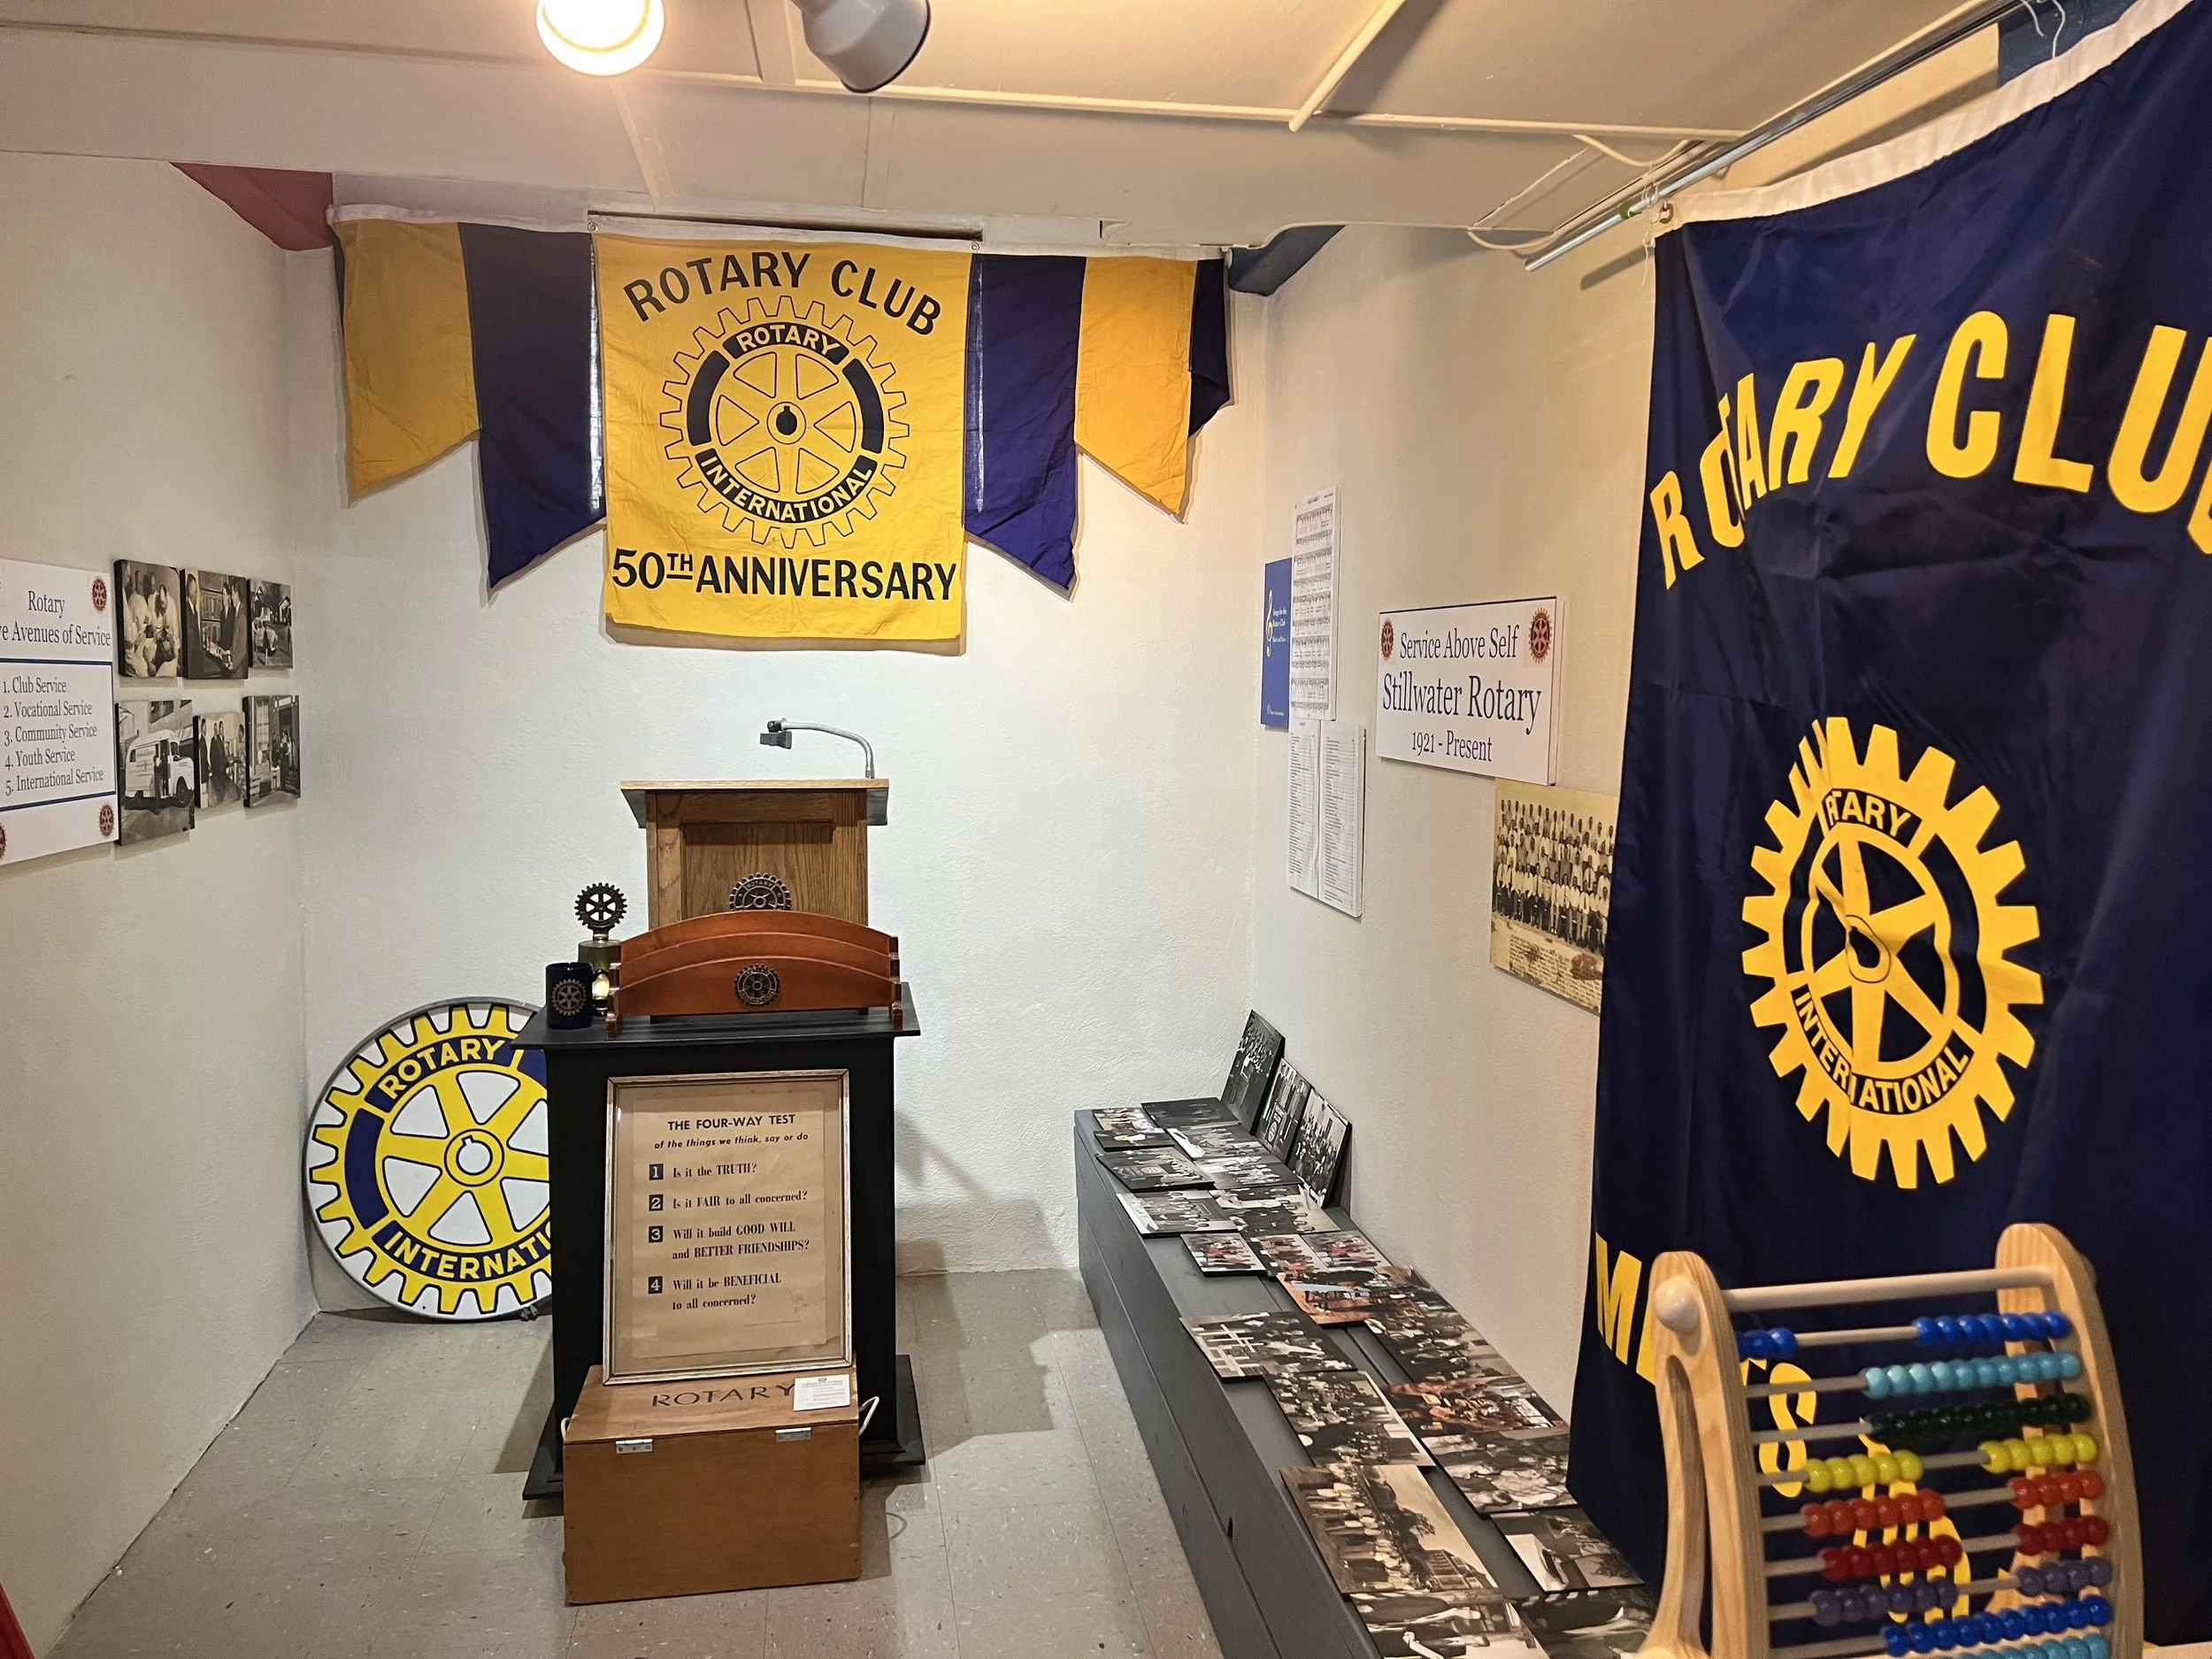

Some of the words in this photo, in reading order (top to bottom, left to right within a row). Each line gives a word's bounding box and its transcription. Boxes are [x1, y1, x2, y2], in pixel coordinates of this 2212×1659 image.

[623, 251, 810, 322] ROTARY
[831, 259, 941, 335] CLUB
[735, 324, 841, 355] ROTARY
[701, 457, 872, 521] INTERNATIONAL
[612, 548, 694, 589] 50TH
[696, 556, 957, 601] ANNIVERSARY
[27, 590, 65, 618] Rotary
[12, 620, 59, 643] Avenues
[62, 624, 73, 644] of
[75, 625, 111, 646] Service
[1400, 630, 1440, 658] Service
[1443, 628, 1486, 658] Above
[1489, 625, 1519, 658] Self
[3, 681, 10, 694] 1.
[12, 676, 34, 694] Club
[36, 677, 66, 694] Service
[4, 706, 12, 718] 2.
[14, 699, 61, 718] Vocational
[64, 700, 92, 716] Service
[1383, 671, 1462, 716] Stillwater
[1467, 675, 1541, 735] Rotary
[4, 731, 12, 747] 3.
[15, 724, 67, 742] Community
[69, 722, 97, 739] Service
[1412, 732, 1434, 757] 1921
[1446, 731, 1493, 762] Present
[5, 756, 14, 772] 4.
[16, 749, 43, 767] Youth
[45, 747, 75, 764] Service
[5, 780, 14, 796] 5.
[17, 768, 73, 791] International
[76, 766, 104, 784] Service
[378, 1038, 505, 1100] ROTARY
[668, 1120, 690, 1131] THE
[695, 1116, 763, 1130] FOUR-WAY
[769, 1114, 796, 1125] TEST
[655, 1141, 664, 1149] of
[667, 1139, 683, 1148] the
[687, 1138, 716, 1148] things
[734, 1135, 762, 1145] think,
[673, 1167, 681, 1178] Is
[685, 1167, 692, 1177] it
[697, 1166, 712, 1177] the
[716, 1163, 757, 1175] TRUTH?
[673, 1198, 681, 1209] Is
[685, 1198, 692, 1209] it
[697, 1196, 720, 1208] FAIR
[739, 1194, 751, 1204] all
[756, 1190, 808, 1203] concerned?
[673, 1228, 692, 1240] Will
[696, 1228, 703, 1239] it
[709, 1226, 732, 1238] build
[736, 1223, 764, 1236] GOOD
[770, 1221, 795, 1233] WILL
[384, 1221, 551, 1279] INTERNATI
[672, 1248, 690, 1260] and
[694, 1245, 733, 1258] BETTER
[738, 1240, 810, 1255] FRIENDSHIPS?
[673, 1279, 692, 1290] Will
[696, 1279, 703, 1289] it
[709, 1278, 719, 1289] be
[724, 1273, 782, 1287] BENEFICIAL
[672, 1302, 682, 1310] to
[687, 1298, 698, 1310] all
[703, 1294, 756, 1308] concerned?
[652, 1384, 795, 1407] ROTARY
